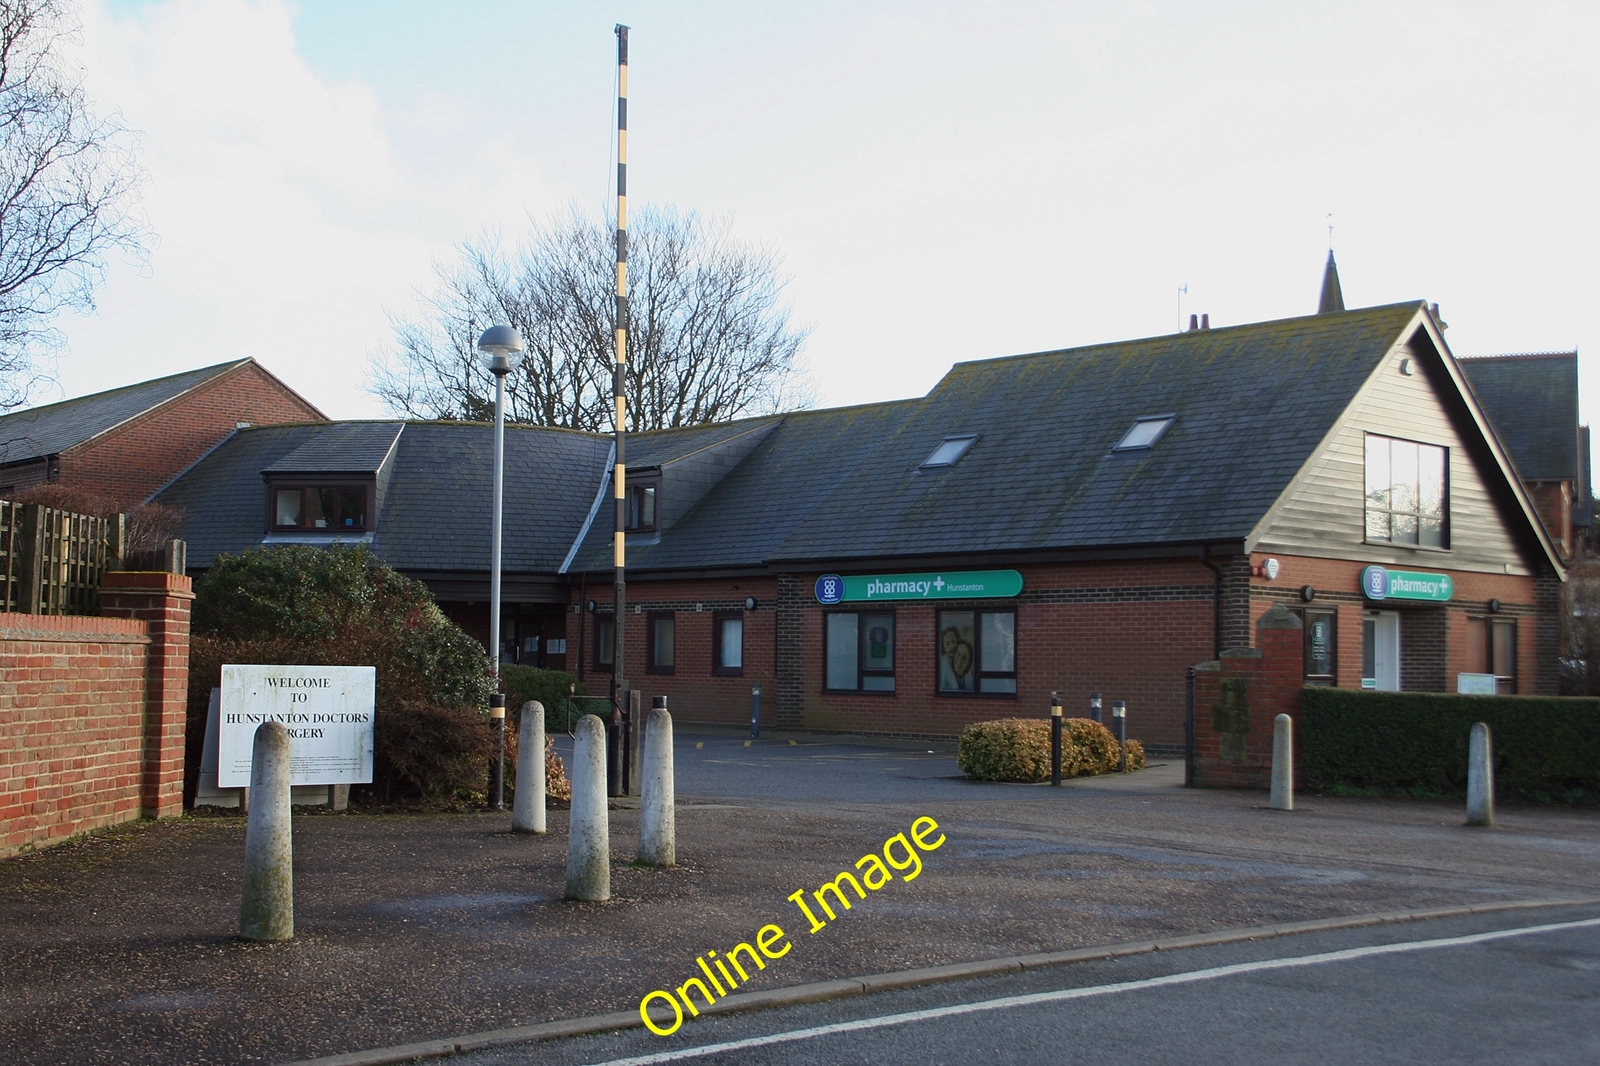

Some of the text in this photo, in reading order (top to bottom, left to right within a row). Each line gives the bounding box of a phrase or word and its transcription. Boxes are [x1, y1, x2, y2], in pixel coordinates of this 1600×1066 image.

[867, 578, 984, 597] pharmacy Hunstanton
[1391, 575, 1438, 597] pharmacy
[267, 677, 331, 689] WELCOME
[290, 692, 308, 703] TO
[226, 713, 369, 724] HUNSTANTON DOCTORS
[287, 728, 326, 738] RGERY
